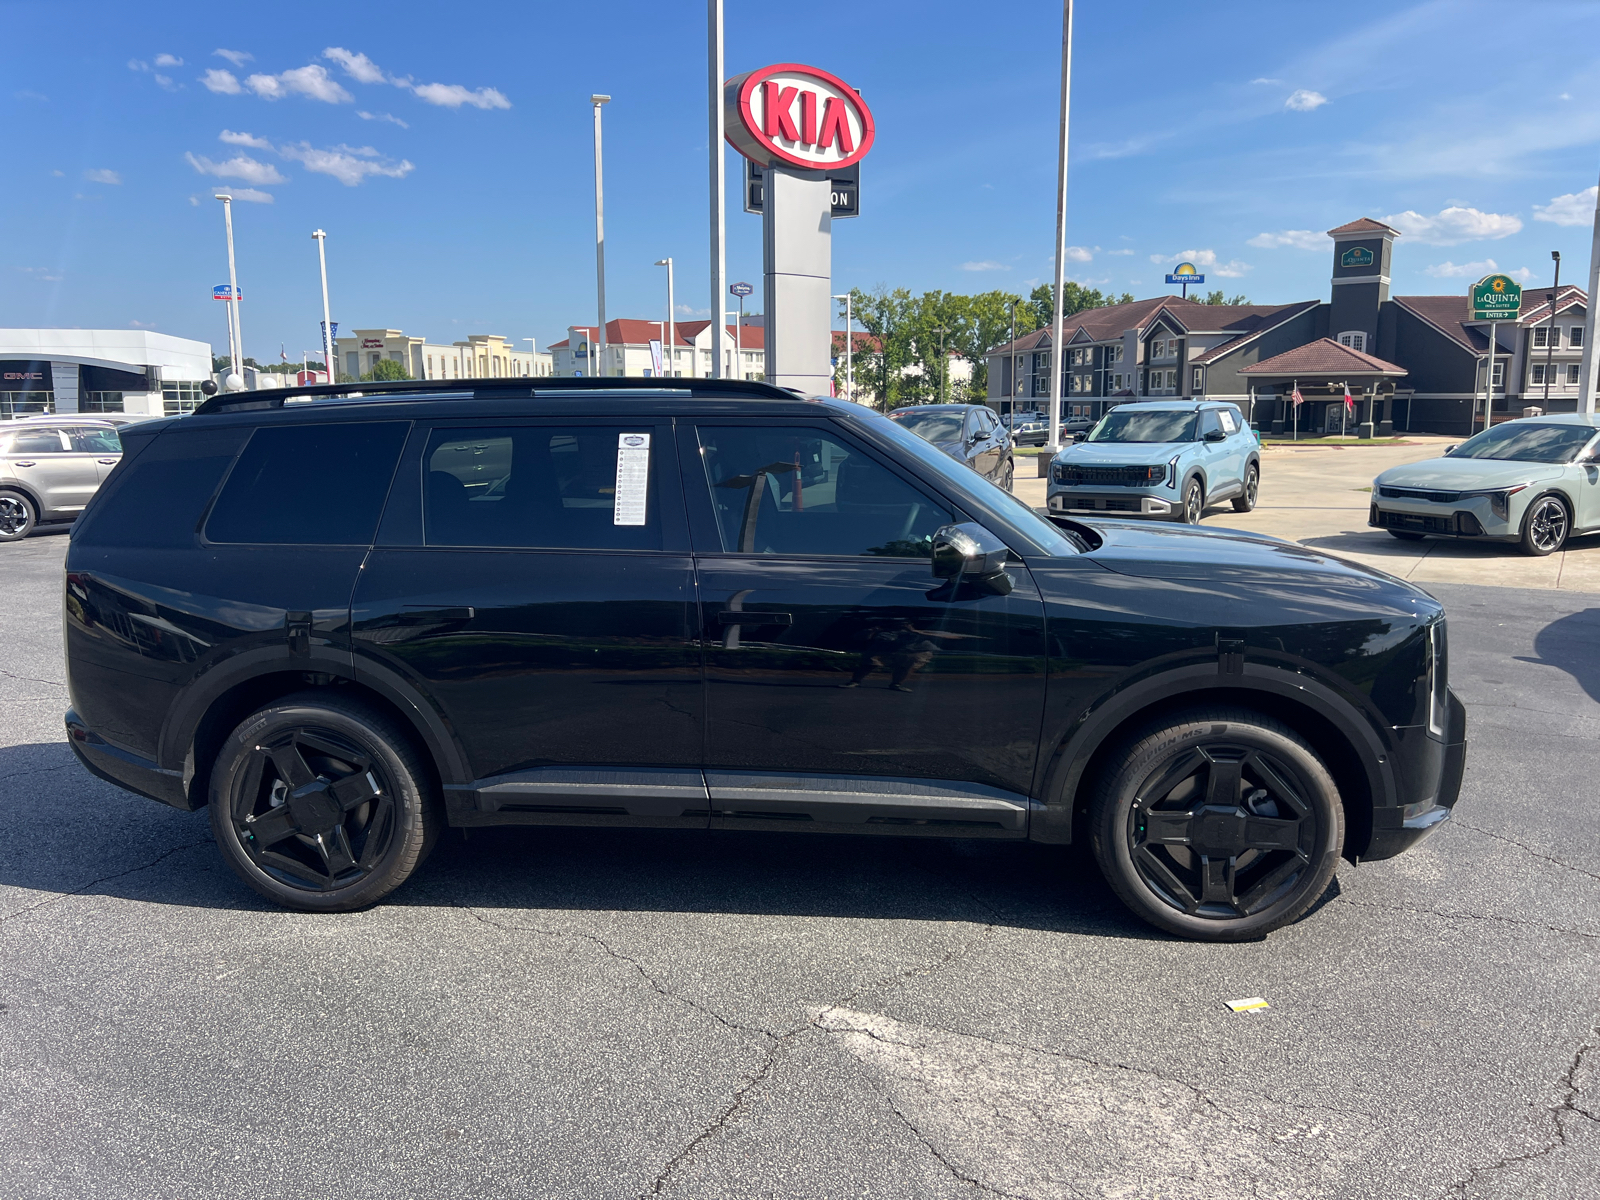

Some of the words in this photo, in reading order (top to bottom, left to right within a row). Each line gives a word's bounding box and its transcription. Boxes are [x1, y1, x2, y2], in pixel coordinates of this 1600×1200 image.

[762, 80, 854, 153] KIA
[1172, 274, 1189, 282] Days
[1484, 293, 1519, 304] QUINTA
[4, 372, 43, 380] GMC
[1122, 737, 1177, 792] SCORPION
[1182, 728, 1204, 740] MS
